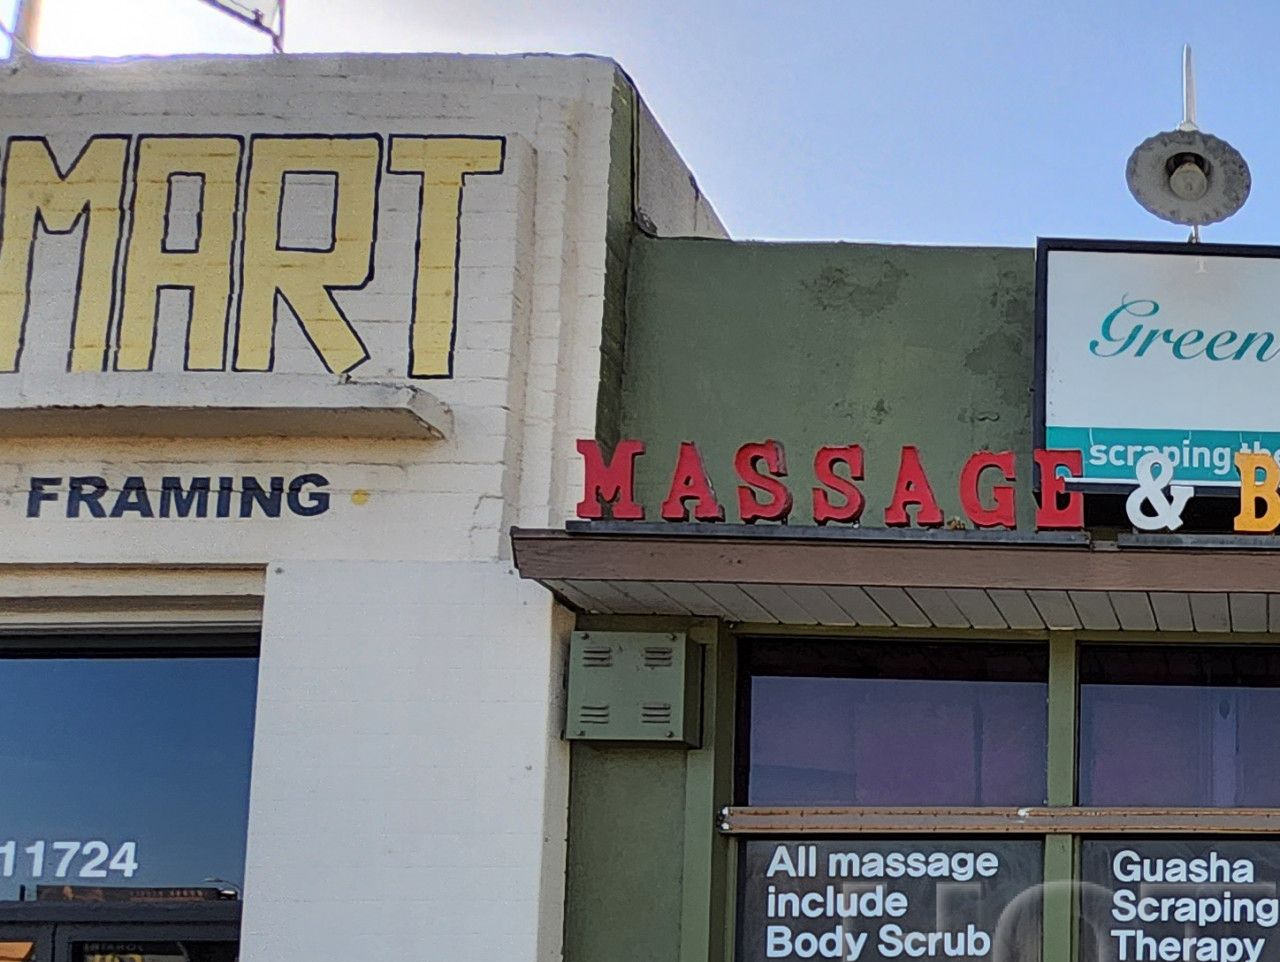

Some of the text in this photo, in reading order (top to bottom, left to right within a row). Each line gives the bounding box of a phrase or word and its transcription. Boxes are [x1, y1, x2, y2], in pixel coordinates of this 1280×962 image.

[0, 133, 506, 379] MART
[26, 474, 331, 518] FRAMING
[576, 439, 1085, 530] MASSAGE
[1126, 452, 1194, 531] &
[0, 841, 138, 877] 11724
[766, 845, 999, 881] All massage
[1112, 850, 1254, 883] Guasha
[767, 885, 908, 918] include
[1111, 889, 1279, 927] Scraping
[766, 924, 991, 962] Body Scrub
